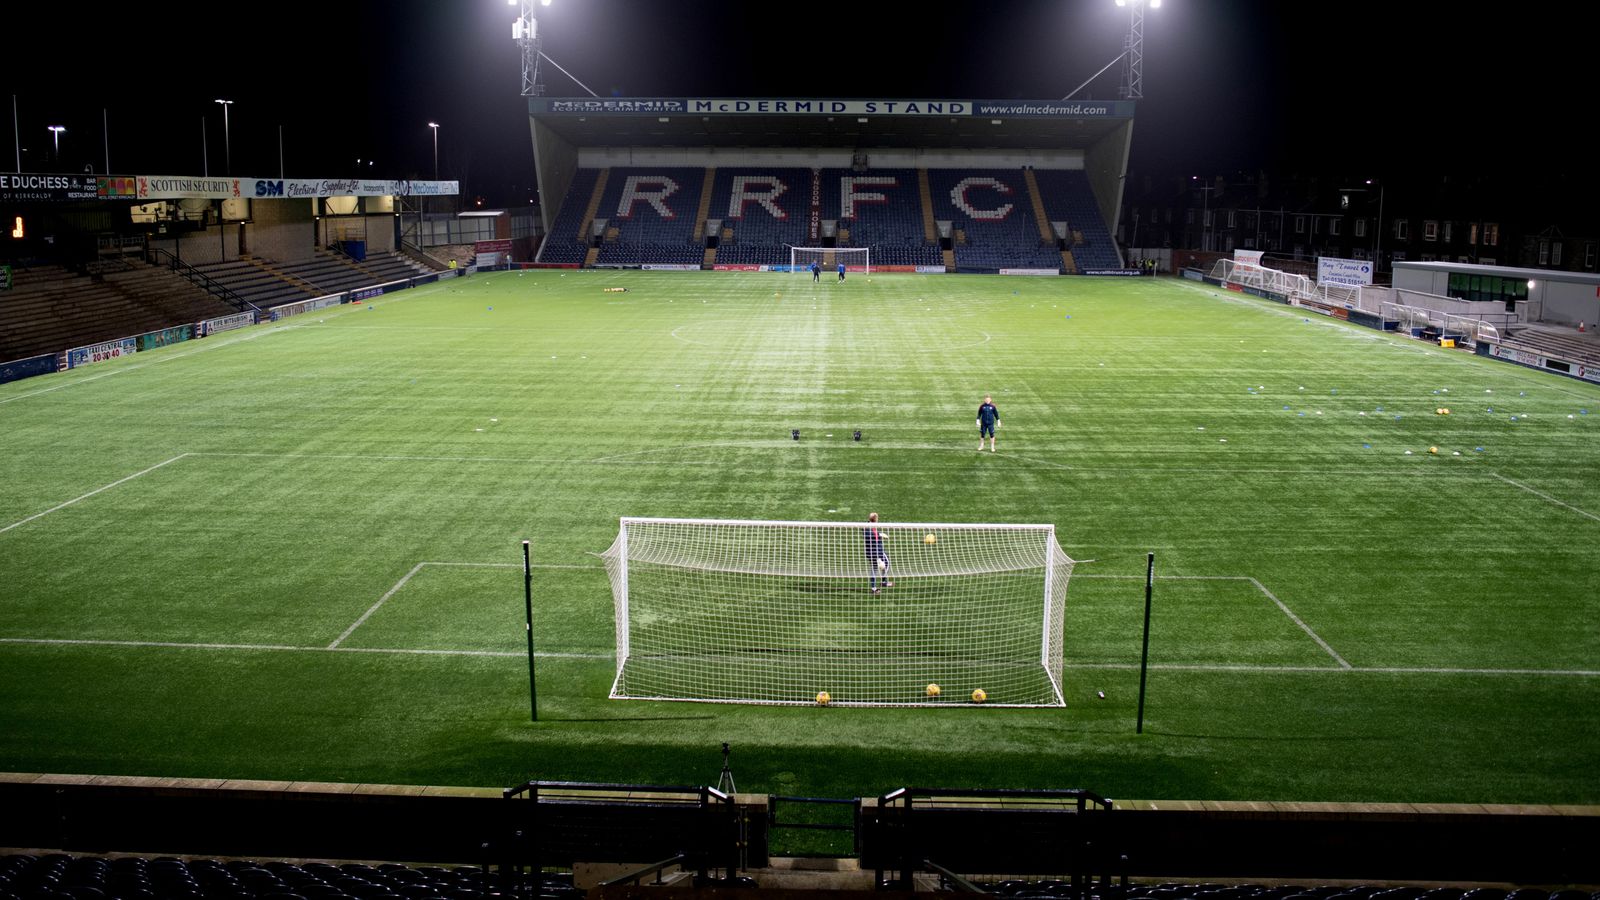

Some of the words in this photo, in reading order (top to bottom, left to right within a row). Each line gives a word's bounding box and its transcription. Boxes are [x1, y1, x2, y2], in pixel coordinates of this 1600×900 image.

[696, 101, 846, 112] McDERMID
[865, 102, 964, 113] STAND
[980, 103, 1107, 115] www.valmcdermid.com
[11, 176, 69, 189] DUCHESS
[150, 179, 192, 192] SCOTTISH
[193, 180, 229, 193] SECURITY
[255, 180, 284, 197] SM
[287, 183, 318, 198] Electrical
[812, 168, 820, 206] KINGDOM
[811, 211, 819, 239] HOMES
[93, 353, 102, 362] 20
[111, 349, 120, 358] 40
